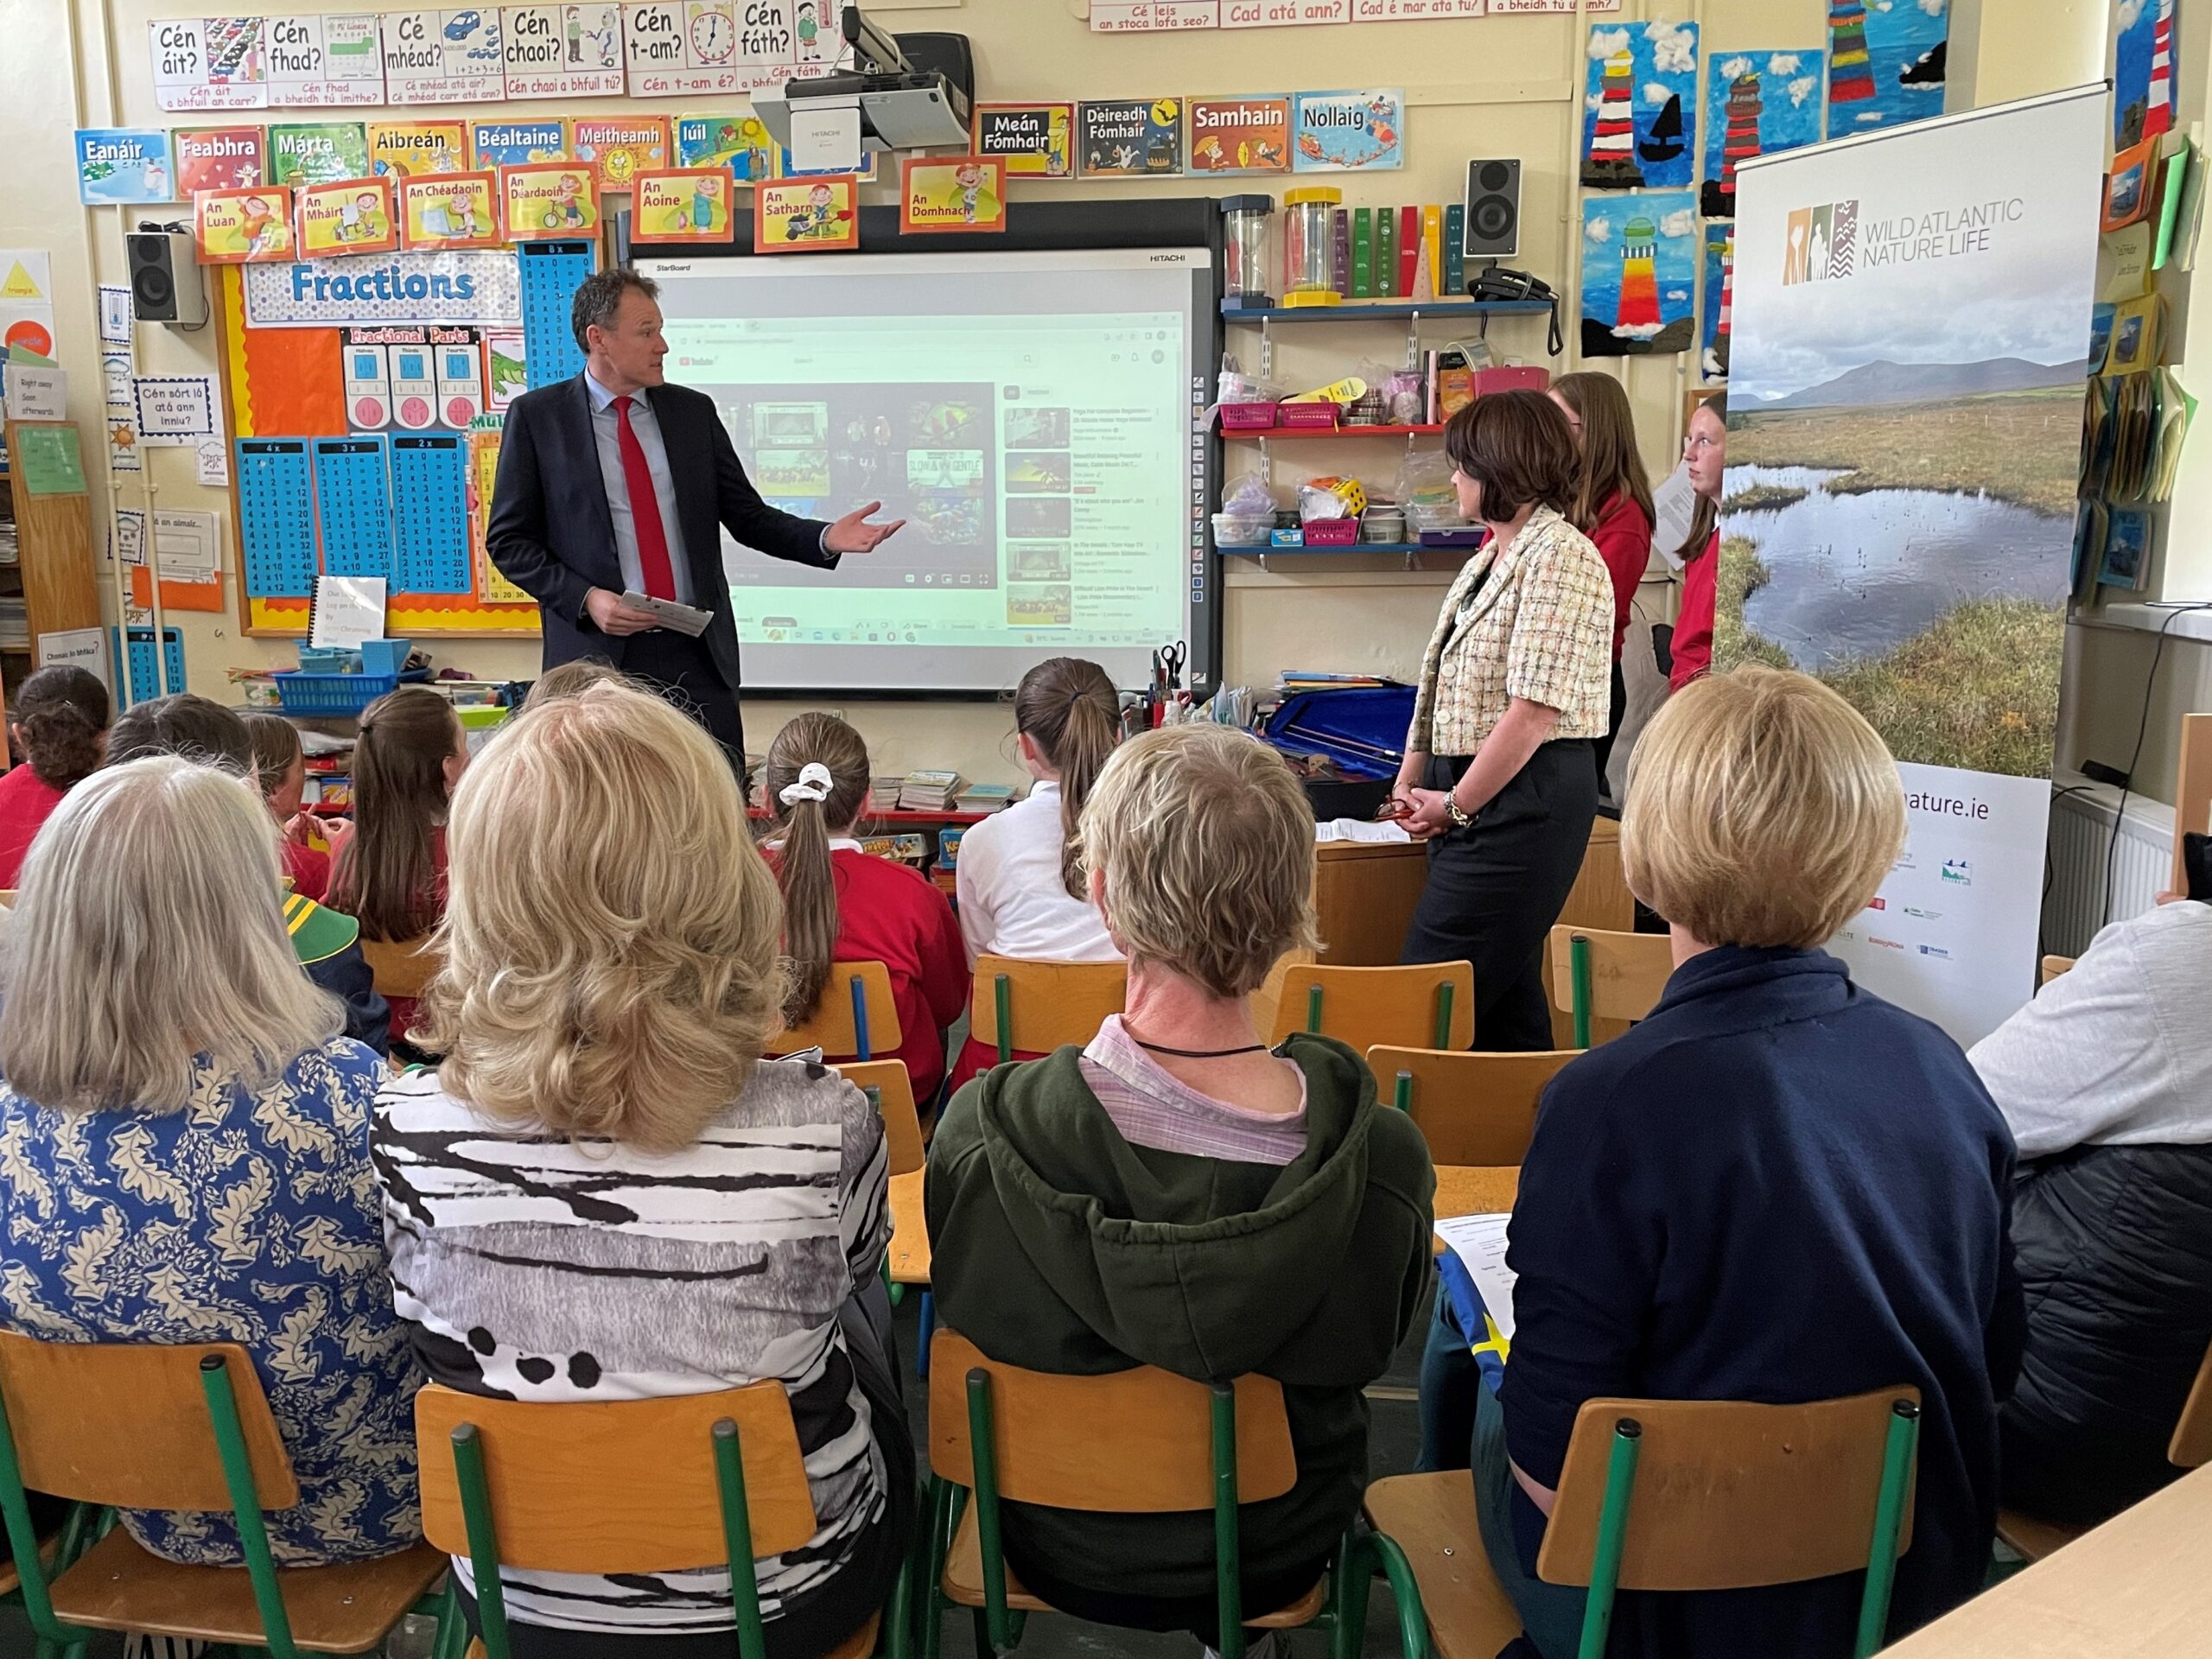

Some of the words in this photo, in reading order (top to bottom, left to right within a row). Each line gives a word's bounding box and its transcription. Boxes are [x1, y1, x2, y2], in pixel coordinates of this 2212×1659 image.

[1132, 6, 1147, 16] Cé
[1154, 5, 1176, 16] leis
[1230, 4, 1261, 22] Cad
[1268, 2, 1296, 19] atá
[1305, 1, 1342, 18] ann?
[1360, 0, 1382, 14] Cad
[1403, 2, 1426, 12] mar
[1510, 0, 1547, 9] bheidh
[634, 6, 672, 33] Cén
[745, 1, 781, 26] Cén
[398, 14, 425, 40] Cé
[514, 10, 550, 35] Cén
[1099, 21, 1112, 29] an
[1118, 19, 1149, 29] stoca
[1155, 17, 1177, 28] lofa
[1183, 16, 1209, 26] seo?
[160, 24, 195, 48] Cén
[274, 19, 309, 43] Cén
[506, 37, 560, 63] chaoi?
[630, 34, 682, 60] t-am?
[741, 29, 790, 55] fáth?
[162, 51, 197, 74] áit?
[270, 47, 321, 73] fhad?
[387, 42, 442, 69] mhéad?
[772, 67, 791, 76] Cén
[798, 66, 821, 76] fáth
[190, 86, 209, 96] Cén
[216, 85, 232, 95] áit
[302, 83, 321, 92] Cén
[326, 83, 349, 92] fhad
[406, 81, 416, 90] Cé
[420, 79, 447, 90] mhéad
[451, 78, 466, 89] atá
[470, 77, 486, 88] air?
[508, 78, 527, 93] Cén
[531, 78, 558, 93] chaoi
[561, 81, 567, 92] a
[570, 76, 600, 92] bhfuil
[605, 74, 620, 90] tú?
[643, 78, 668, 92] Cén
[675, 77, 711, 89] t-am
[719, 74, 734, 88] é?
[177, 97, 207, 107] bhfuil
[229, 95, 257, 106] carr?
[285, 93, 319, 104] bheidh
[325, 93, 335, 104] tú
[392, 92, 403, 102] Cé
[408, 92, 436, 100] mhéad
[461, 91, 477, 99] atá
[481, 90, 501, 99] ann?
[994, 116, 1039, 131] Meán
[1087, 107, 1147, 124] Deireadh
[1195, 104, 1284, 128] Samhain
[1304, 106, 1364, 130] Nollaig
[377, 130, 445, 149] Aibreán
[479, 126, 560, 147] Béaltaine
[581, 127, 660, 144] Meitheamh
[683, 123, 706, 142] Iúil
[1090, 124, 1145, 140] Fómhair
[181, 137, 256, 158] Feabhra
[278, 133, 334, 154] Márta
[984, 133, 1049, 149] Fómhair
[86, 140, 143, 160] Eanáir
[511, 176, 524, 187] An
[643, 181, 660, 193] An
[410, 188, 423, 199] An
[425, 183, 482, 197] Chéadaoin
[511, 187, 563, 200] Déardaoin
[766, 192, 782, 202] An
[912, 194, 927, 204] An
[206, 203, 221, 214] An
[306, 197, 321, 208] An
[643, 195, 680, 207] Aoine
[766, 203, 812, 215] Satharn
[307, 207, 344, 221] Mháirt
[912, 206, 970, 217] Domhnach
[207, 216, 235, 226] Luan
[1866, 217, 1915, 244] WILD
[1918, 198, 2024, 237] ATLANTIC
[1864, 242, 1943, 268] NATURE
[1949, 228, 1990, 256] LIFE
[292, 264, 474, 301] Fractions
[350, 327, 425, 344] Fractional
[430, 328, 469, 342] Parts
[143, 389, 166, 398] Cén
[169, 388, 190, 397] sórt
[194, 388, 202, 397] lá
[156, 403, 173, 411] atá
